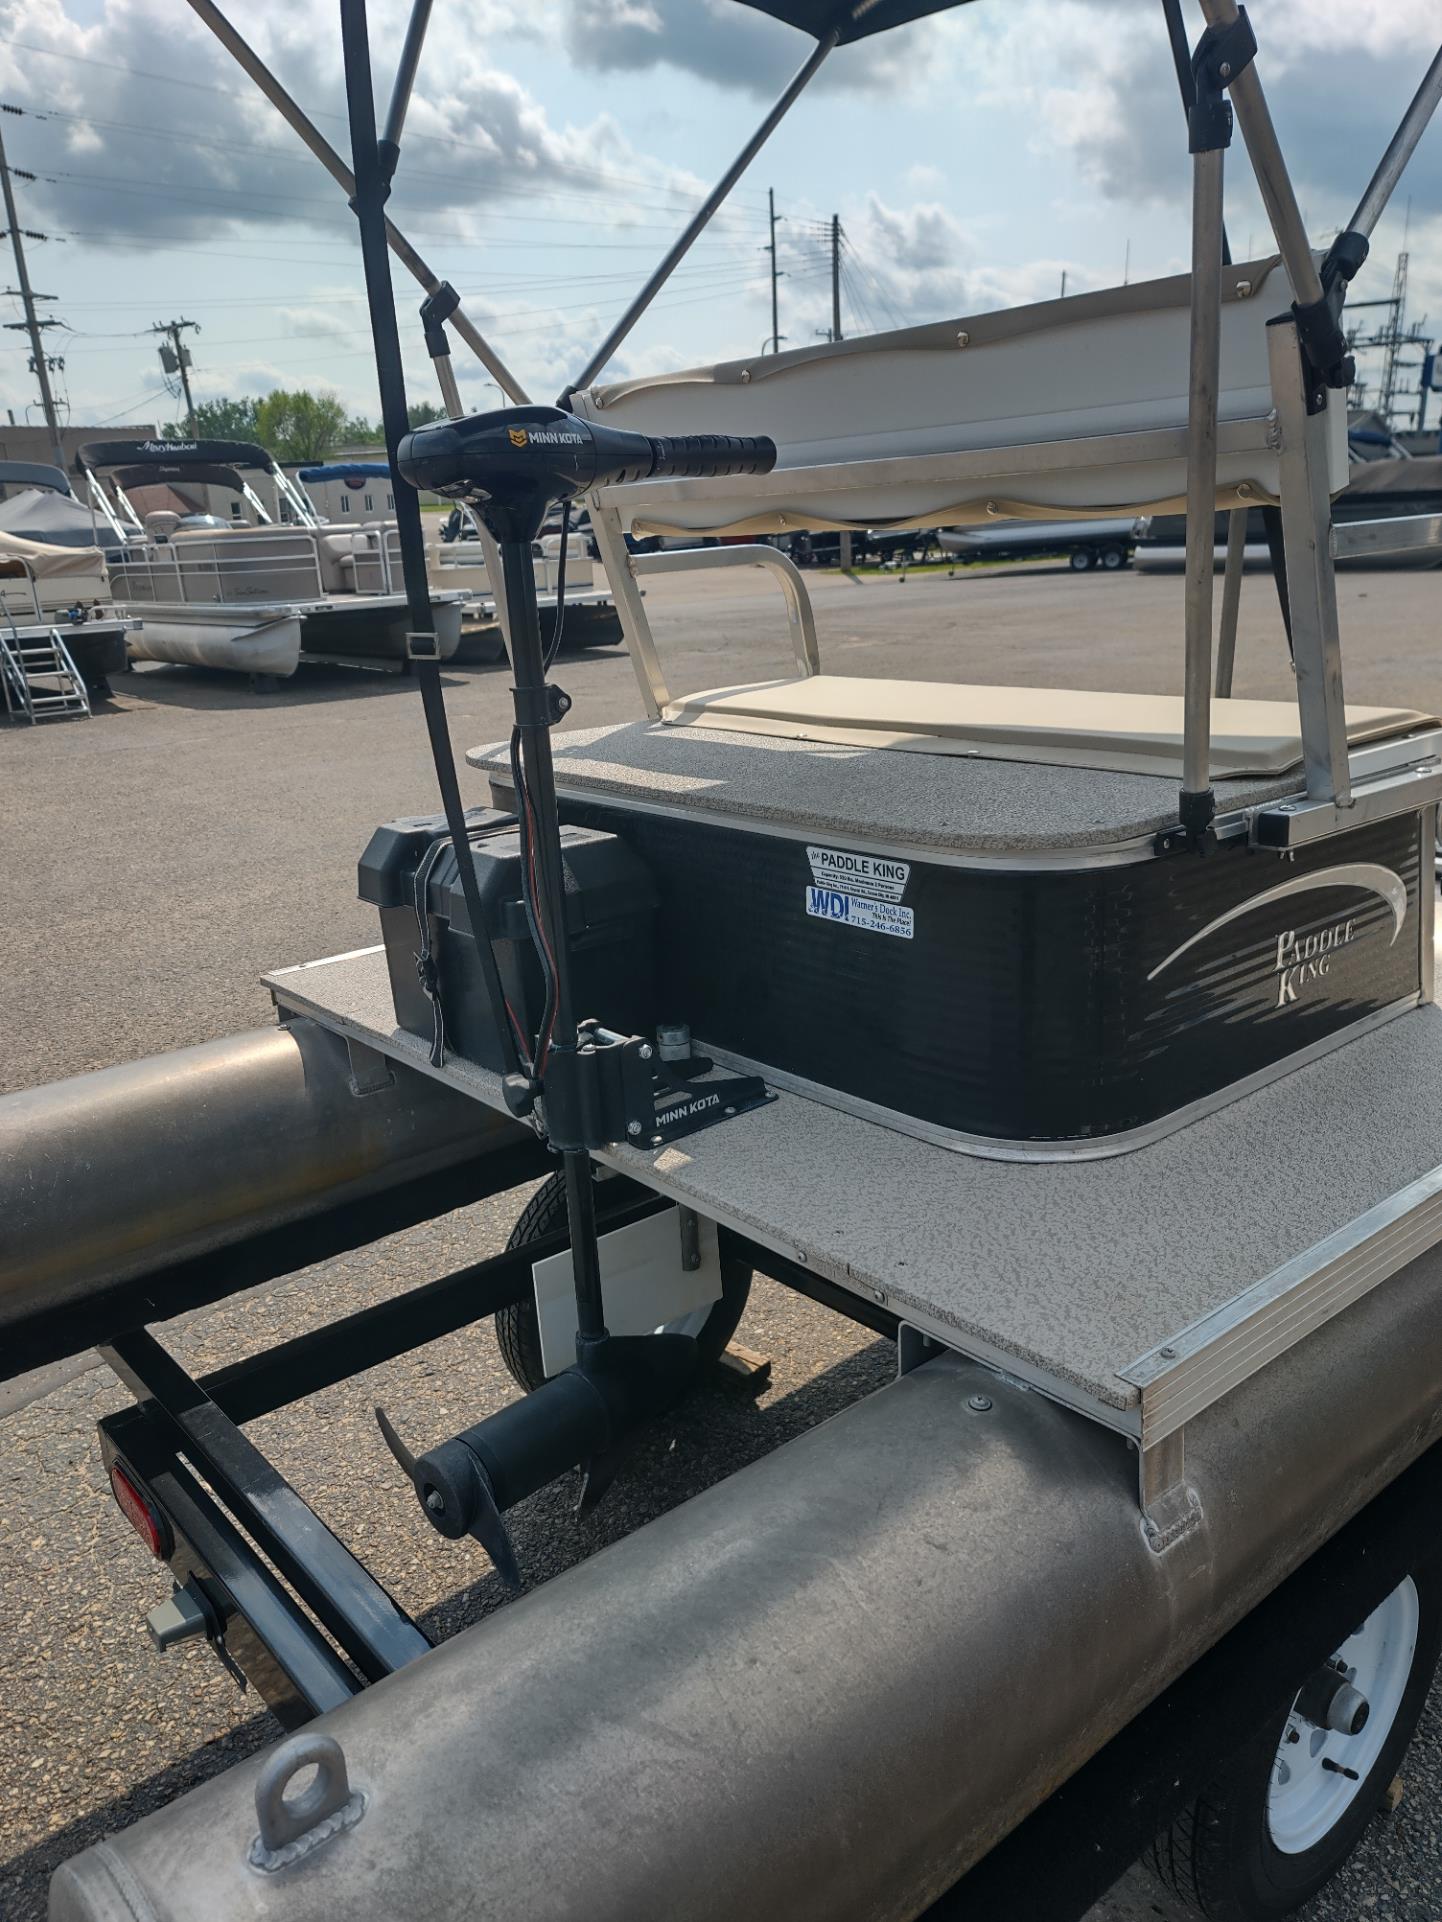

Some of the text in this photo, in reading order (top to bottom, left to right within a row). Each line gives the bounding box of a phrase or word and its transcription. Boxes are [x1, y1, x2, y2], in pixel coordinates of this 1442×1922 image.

[528, 431, 584, 445] MINN KOTA
[821, 852, 905, 881] PADDLE KING
[880, 903, 897, 917] Dock
[851, 915, 912, 937] 715-246-6856
[1273, 919, 1357, 972] PADDLE
[1275, 954, 1332, 1009] KING
[655, 1094, 720, 1127] MINN KOTA
